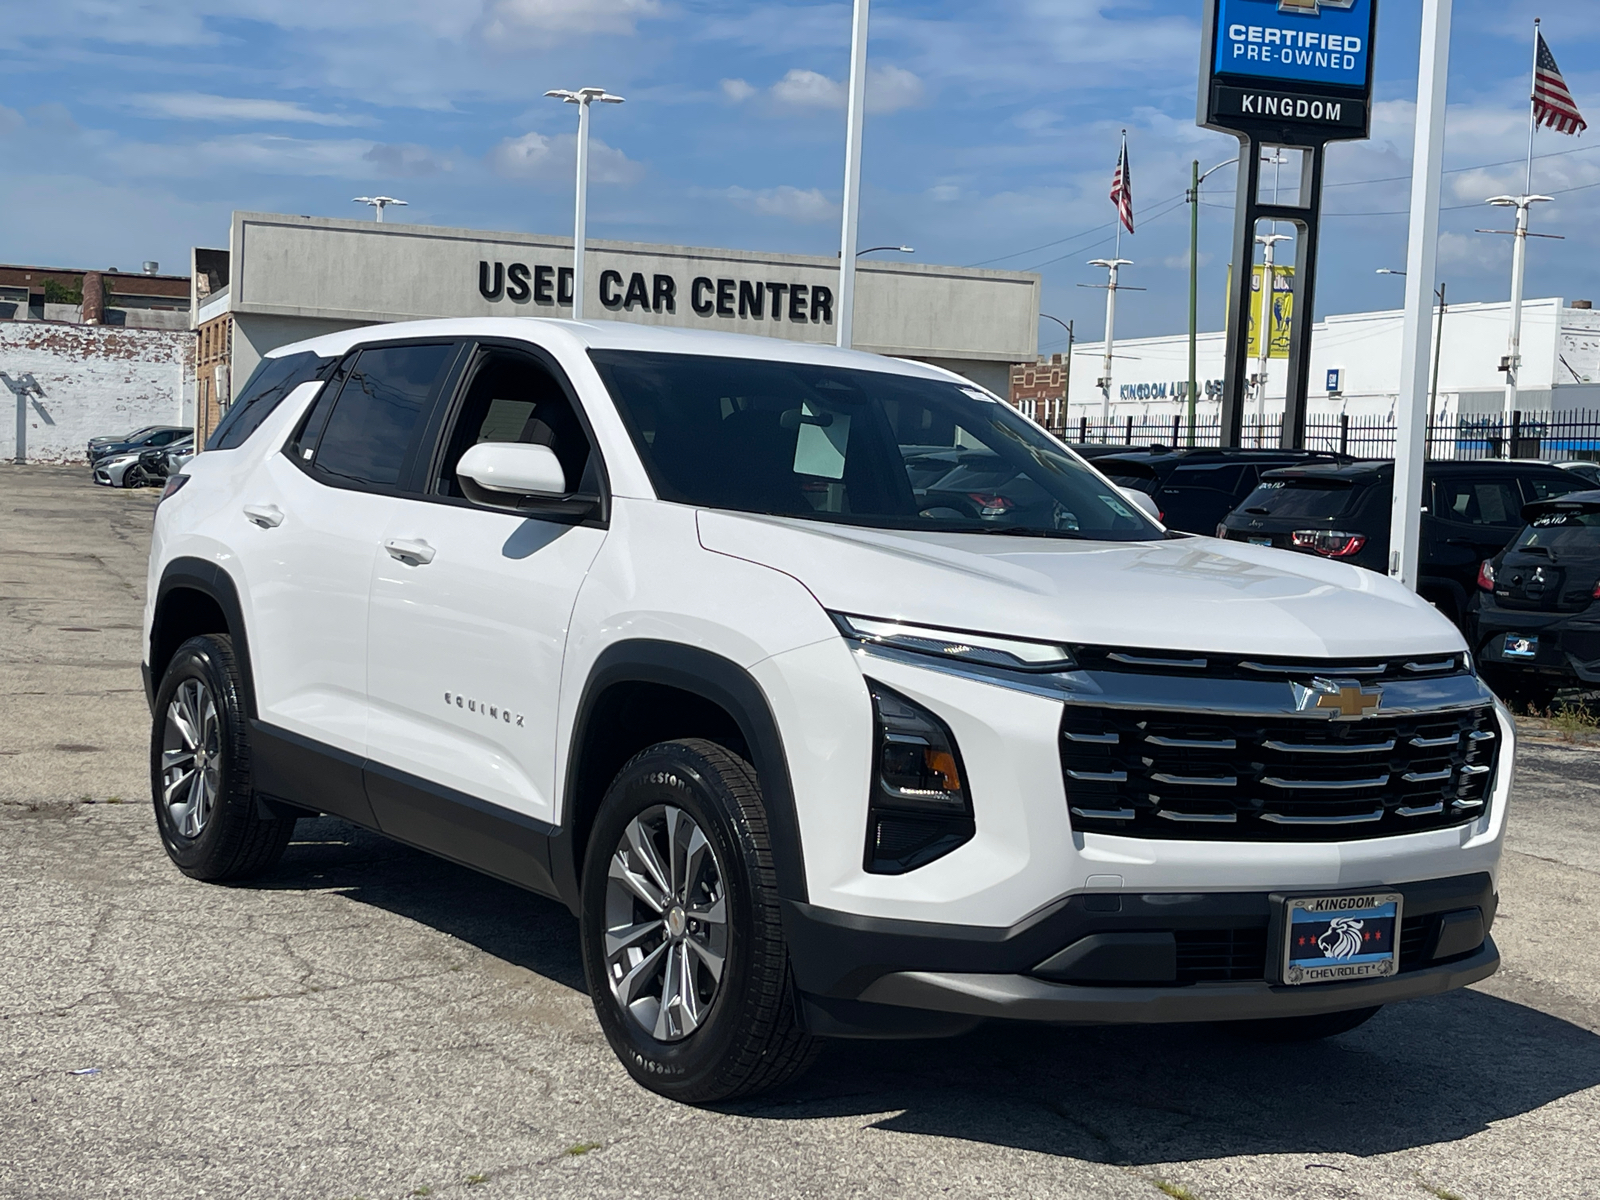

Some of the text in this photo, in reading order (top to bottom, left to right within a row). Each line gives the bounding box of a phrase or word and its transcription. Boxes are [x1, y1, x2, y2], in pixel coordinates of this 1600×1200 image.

[1229, 24, 1361, 53] CERTIFIED
[1233, 43, 1355, 70] PRE-OWNED
[1242, 94, 1341, 121] KINGDOM
[479, 260, 833, 322] USED CAR CENTER
[1120, 383, 1167, 399] KINGDOM
[444, 691, 525, 728] EQUINOX
[1315, 896, 1375, 911] KINGDOM
[1310, 965, 1370, 979] CHEVROLET
